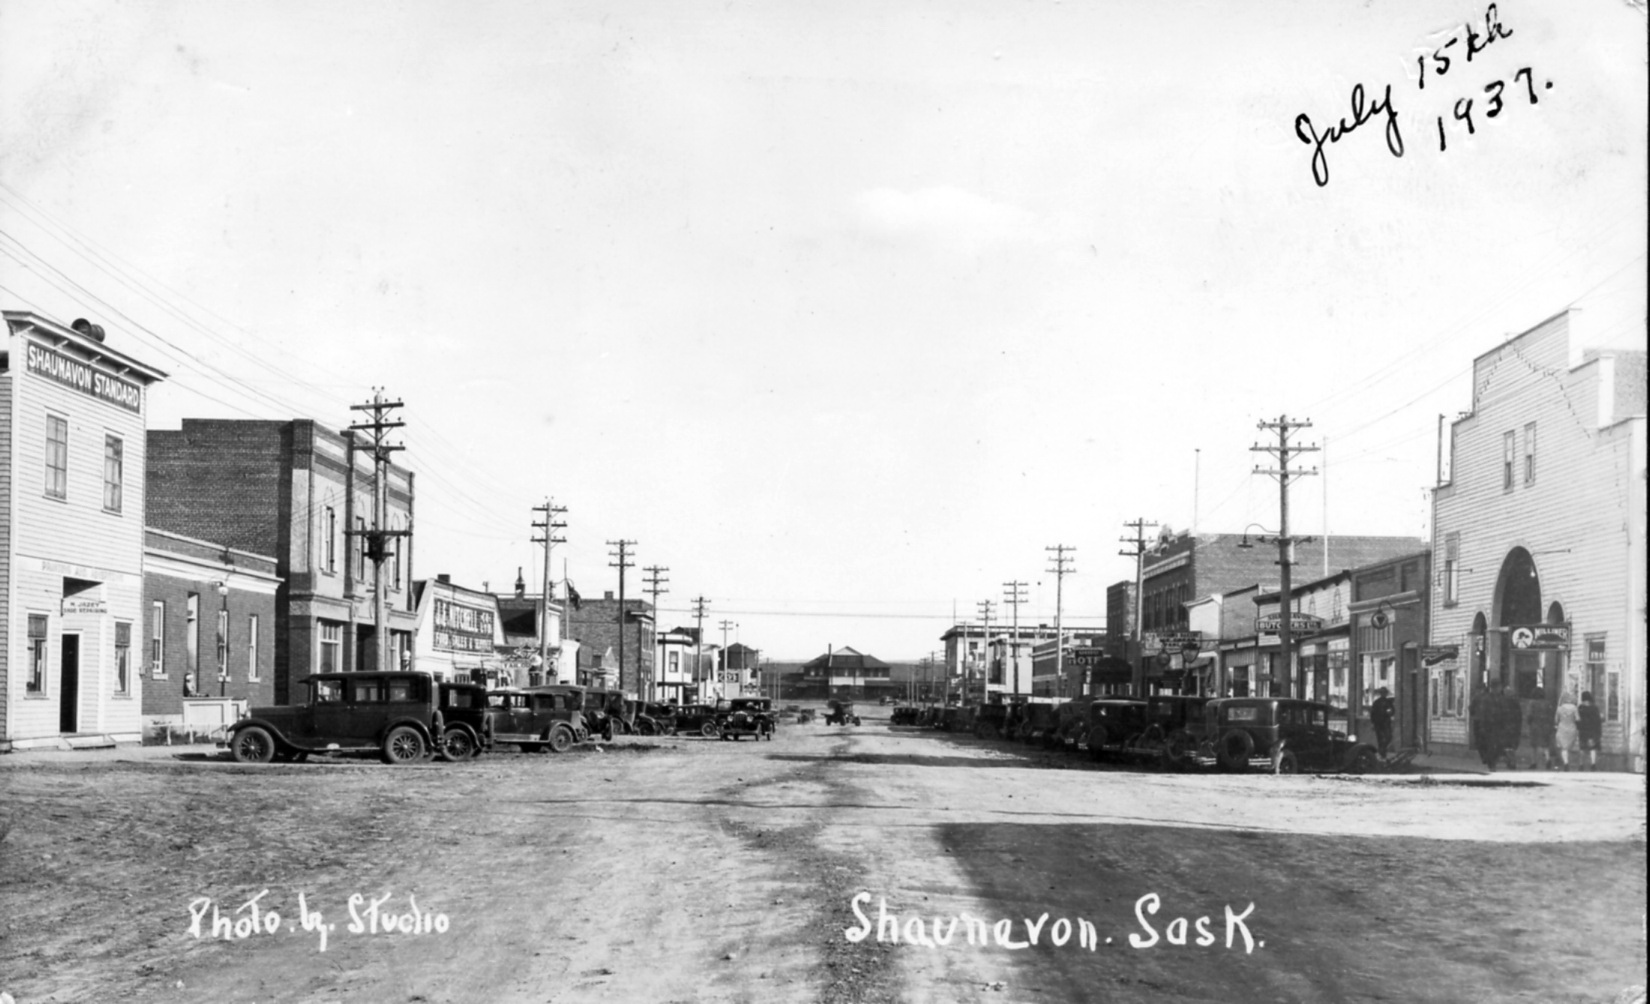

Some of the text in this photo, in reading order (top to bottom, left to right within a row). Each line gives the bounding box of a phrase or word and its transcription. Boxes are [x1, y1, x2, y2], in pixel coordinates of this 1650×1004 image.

[28, 344, 139, 408] SHAUNAVON STANDARD
[449, 604, 479, 633] MITCHELL
[1258, 620, 1305, 629] BUTCRS
[1067, 656, 1100, 665] HOT
